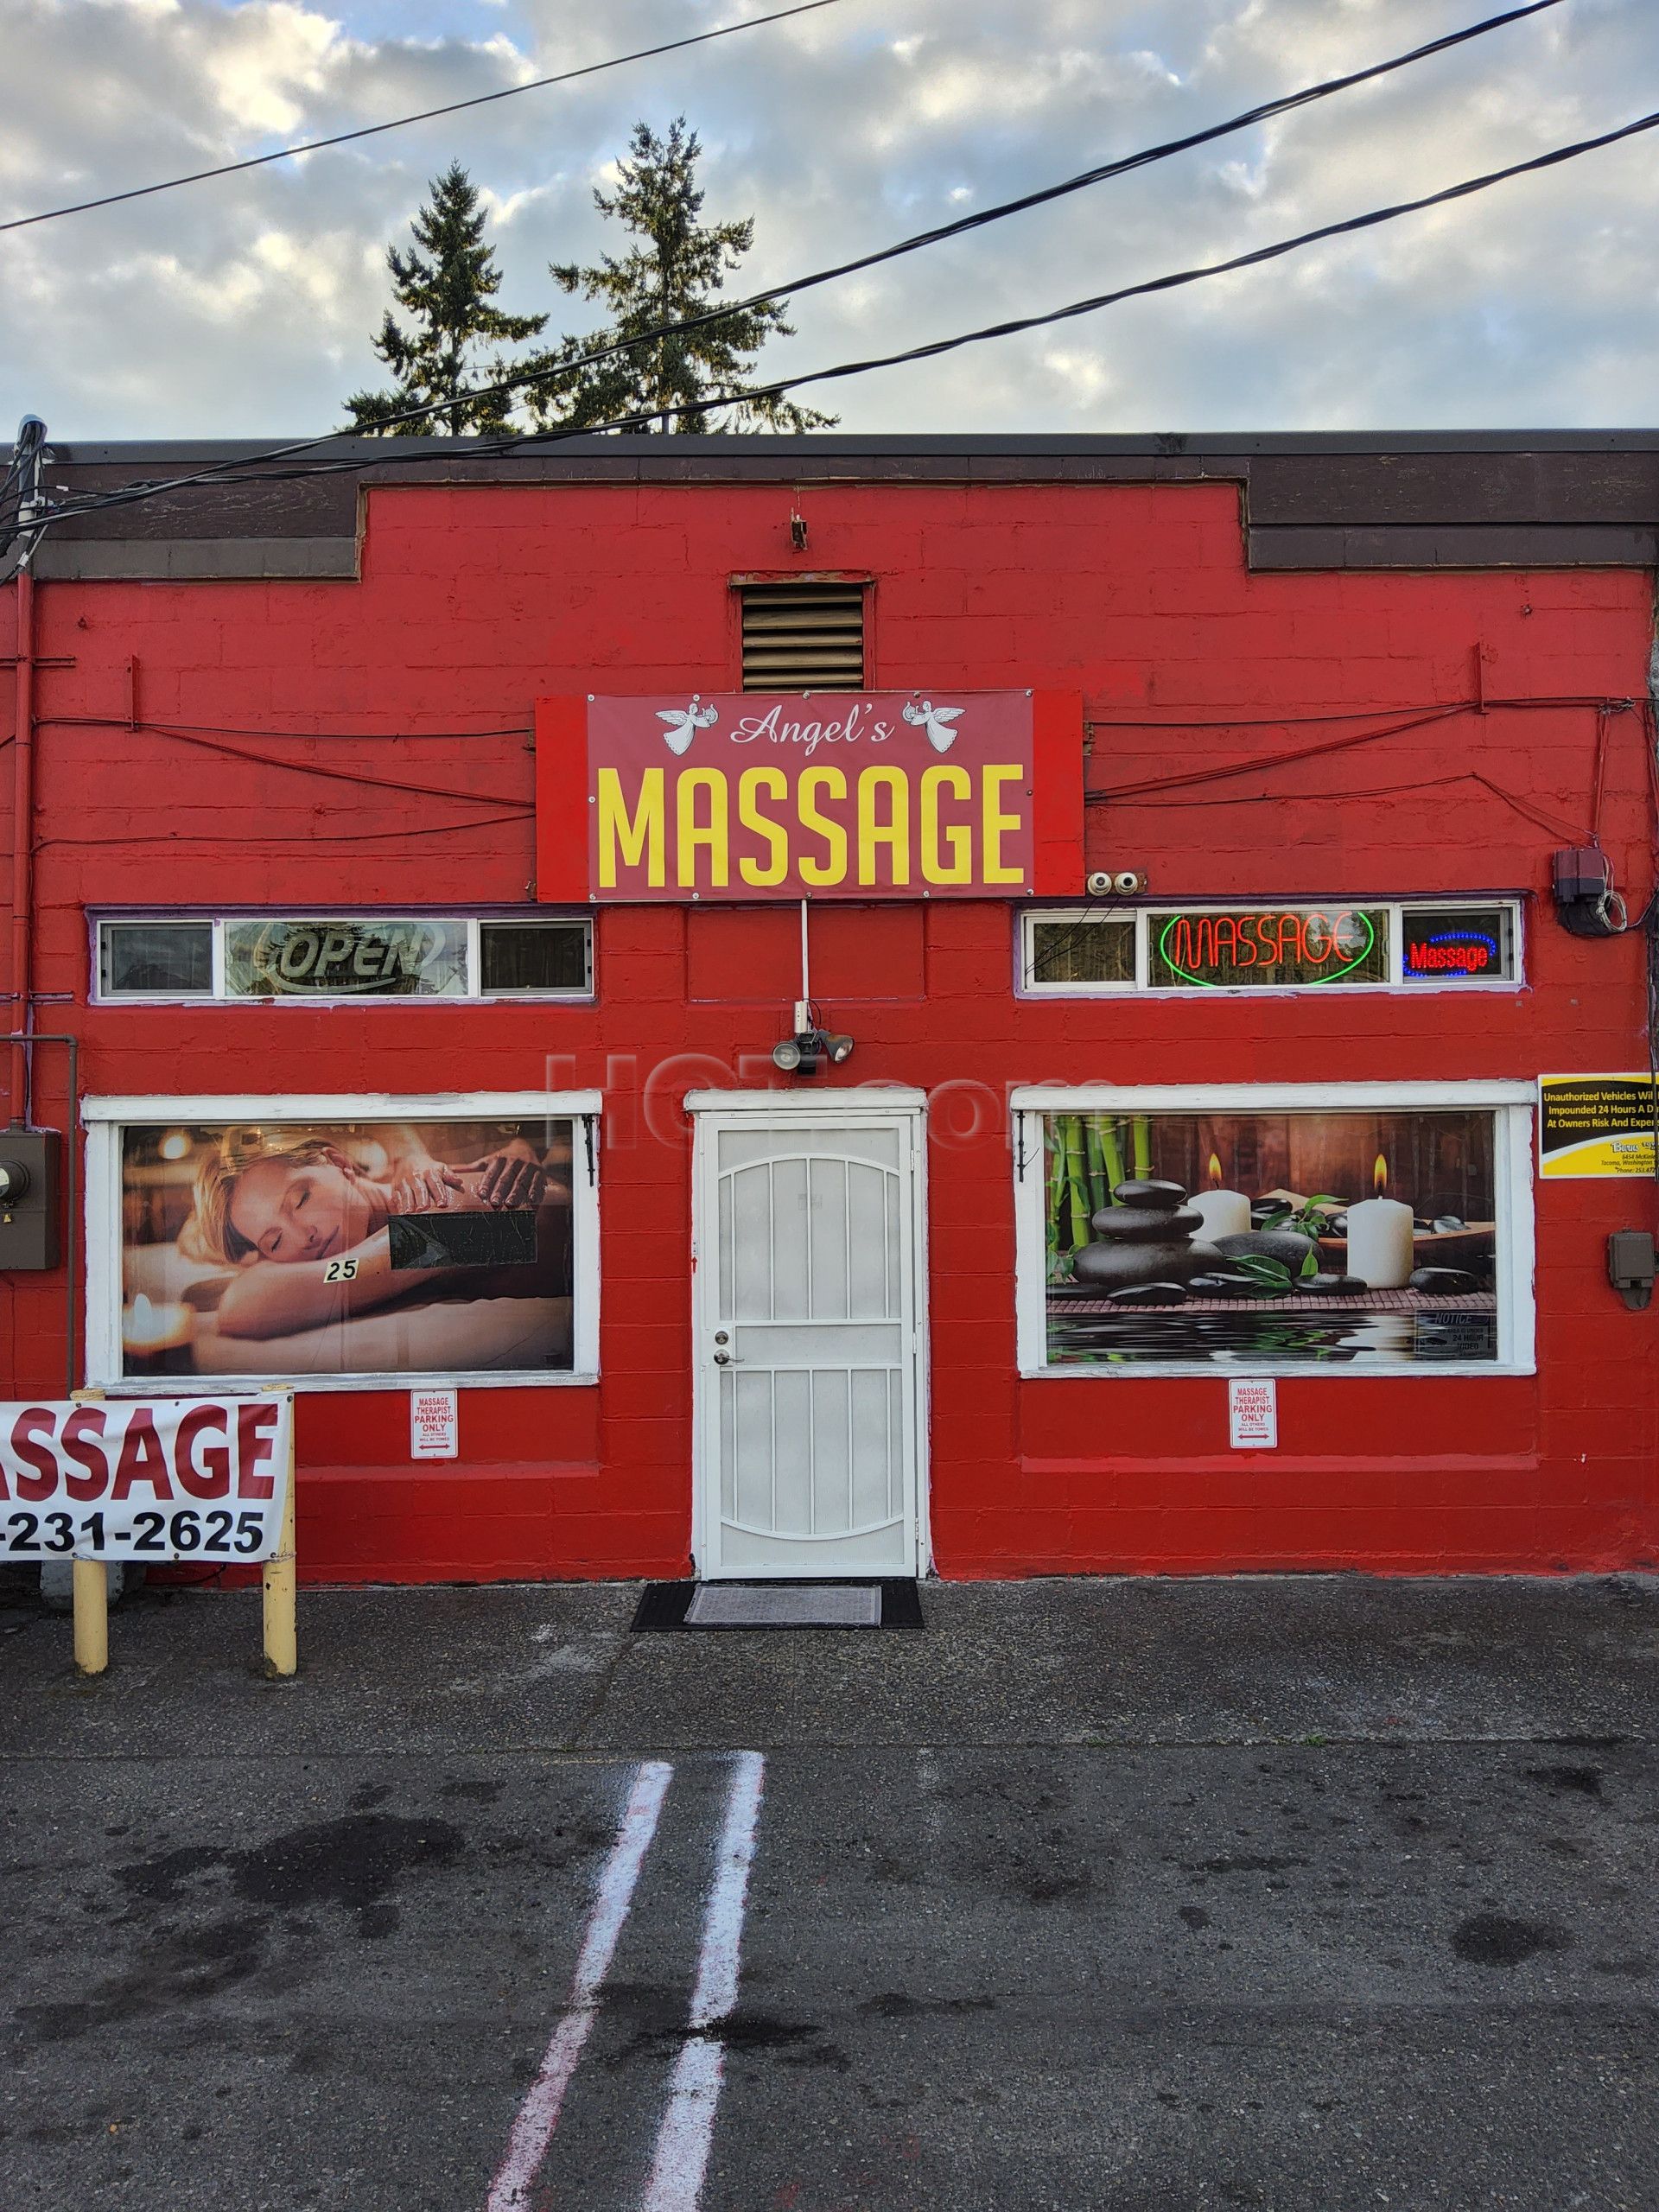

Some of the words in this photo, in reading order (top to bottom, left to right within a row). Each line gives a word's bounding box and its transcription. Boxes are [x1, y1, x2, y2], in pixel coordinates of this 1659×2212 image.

[730, 703, 895, 757] Angel's
[597, 764, 1026, 888] MASSAGE
[1175, 911, 1354, 969] MASSAGE
[280, 922, 427, 977] OPEN
[1410, 942, 1488, 972] Massage
[1543, 1092, 1599, 1102] Unauthorized
[1601, 1091, 1637, 1101] Vehicles
[1548, 1105, 1597, 1116] Impounded
[1598, 1105, 1609, 1115] 24
[1611, 1105, 1637, 1114] Hours
[1637, 1104, 1645, 1114] A
[1547, 1119, 1557, 1128] At
[1558, 1119, 1591, 1128] Owners
[1592, 1118, 1610, 1128] Risk
[1611, 1118, 1629, 1127] And
[327, 1260, 357, 1281] 25
[1435, 1313, 1472, 1324] NOTICE
[419, 1397, 448, 1406] MASSAGE
[1235, 1396, 1270, 1405] THERAPIST
[1233, 1405, 1273, 1414] PARKING
